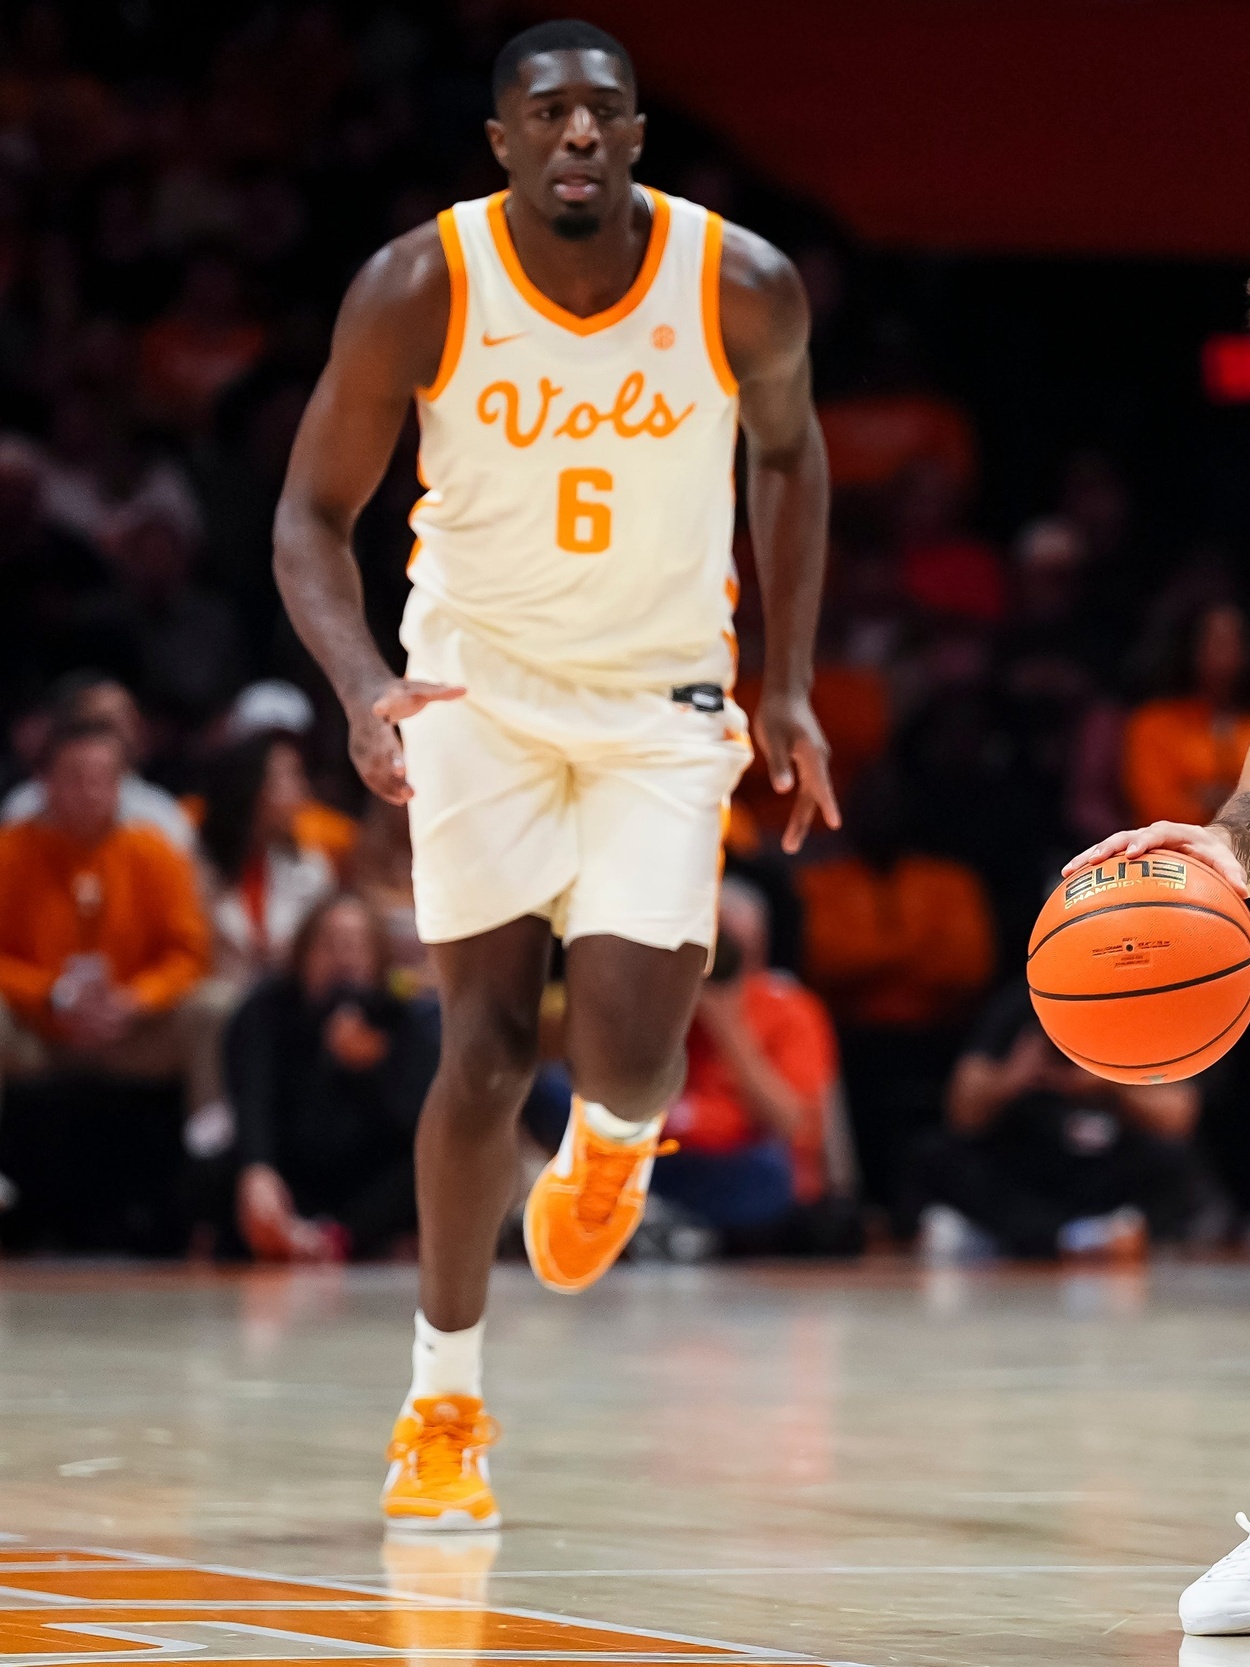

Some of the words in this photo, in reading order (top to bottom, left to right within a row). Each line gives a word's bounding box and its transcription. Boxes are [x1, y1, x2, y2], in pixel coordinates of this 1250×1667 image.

[477, 371, 695, 448] Vols
[556, 467, 613, 554] 6
[1065, 860, 1187, 901] ELITE
